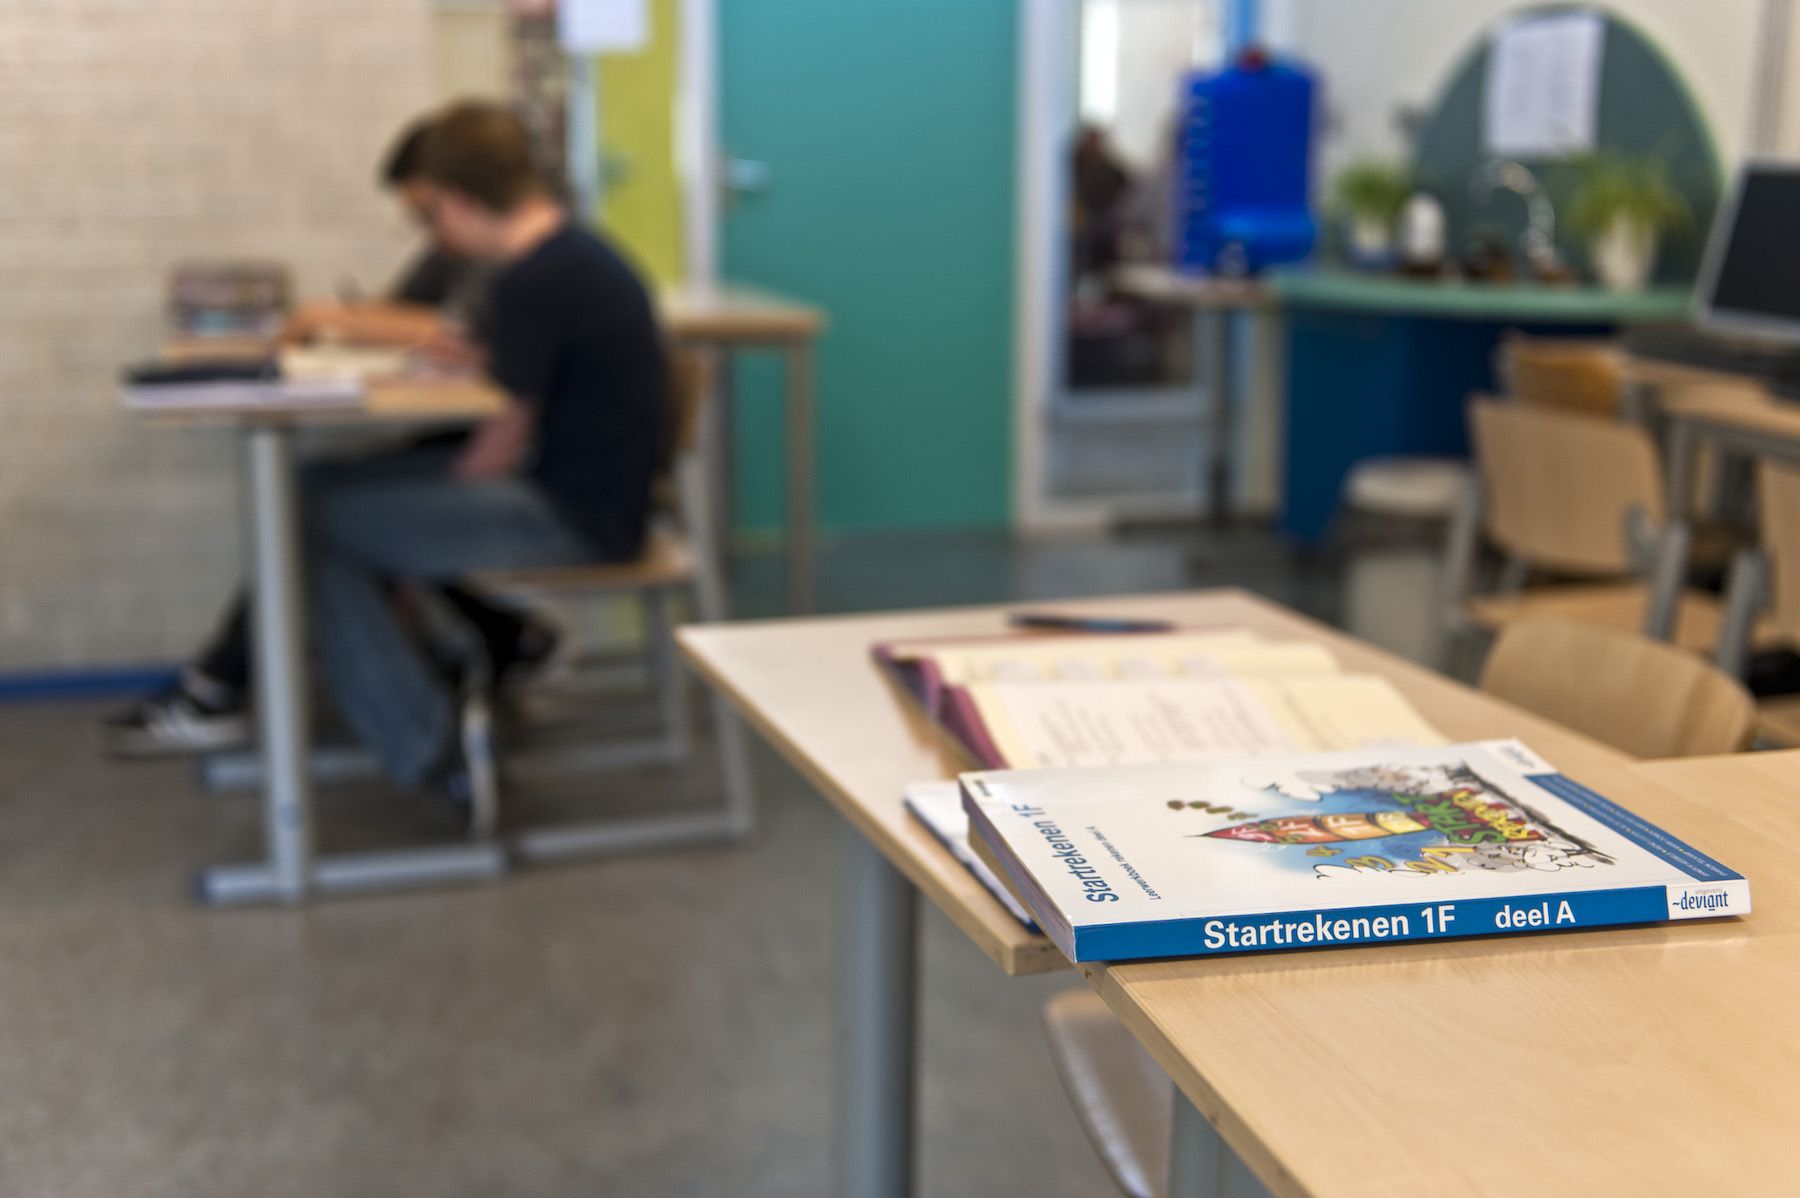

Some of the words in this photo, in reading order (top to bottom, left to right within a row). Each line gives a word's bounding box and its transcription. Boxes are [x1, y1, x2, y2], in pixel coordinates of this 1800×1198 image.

[1012, 804, 1046, 818] 1F
[1033, 820, 1119, 902] Startrekenen
[1203, 913, 1409, 949] Startrekenen
[1420, 904, 1455, 933] 1F
[1495, 901, 1550, 928] deel
[1556, 900, 1576, 924] A
